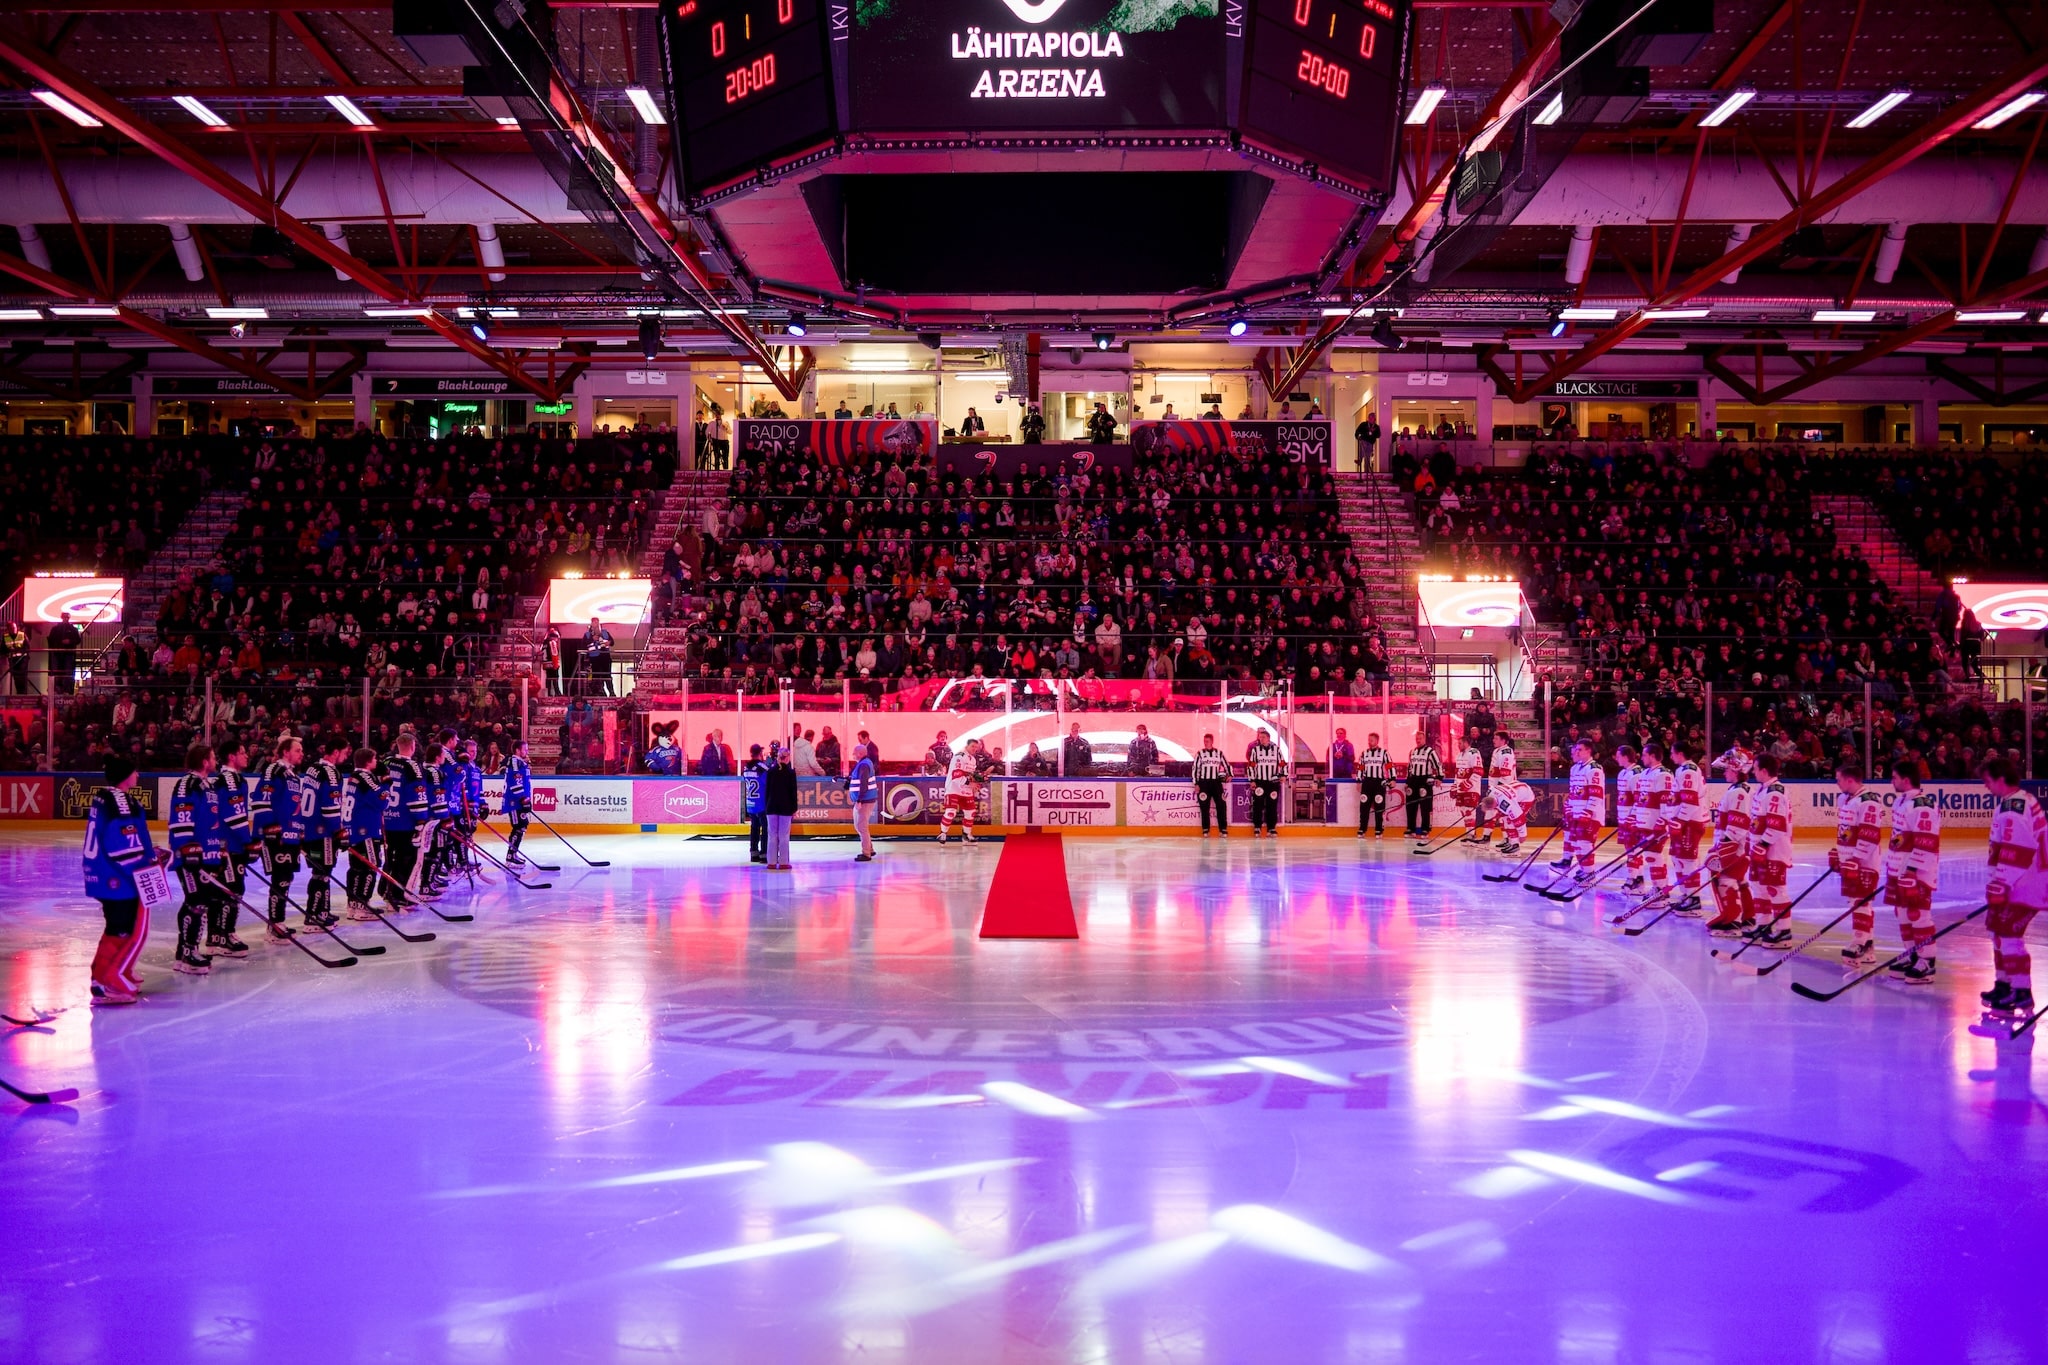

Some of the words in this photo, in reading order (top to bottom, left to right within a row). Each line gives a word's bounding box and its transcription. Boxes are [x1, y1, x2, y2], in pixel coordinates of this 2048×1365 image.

[832, 5, 849, 41] LKV
[711, 21, 724, 58] 0
[951, 26, 1124, 59] LÄHITAPIOLA
[1360, 24, 1376, 58] 0
[726, 53, 776, 103] 20:00
[1298, 50, 1350, 99] 20:00
[970, 69, 1106, 98] AREENA
[437, 380, 508, 394] BlackLounge
[749, 424, 799, 440] RADIO
[1276, 426, 1328, 441] RADIO
[533, 793, 556, 805] Plus
[563, 794, 628, 806] Katsastus
[668, 797, 705, 807] JYTAKSI
[177, 811, 192, 823] 92
[1048, 811, 1092, 825] PUTKI
